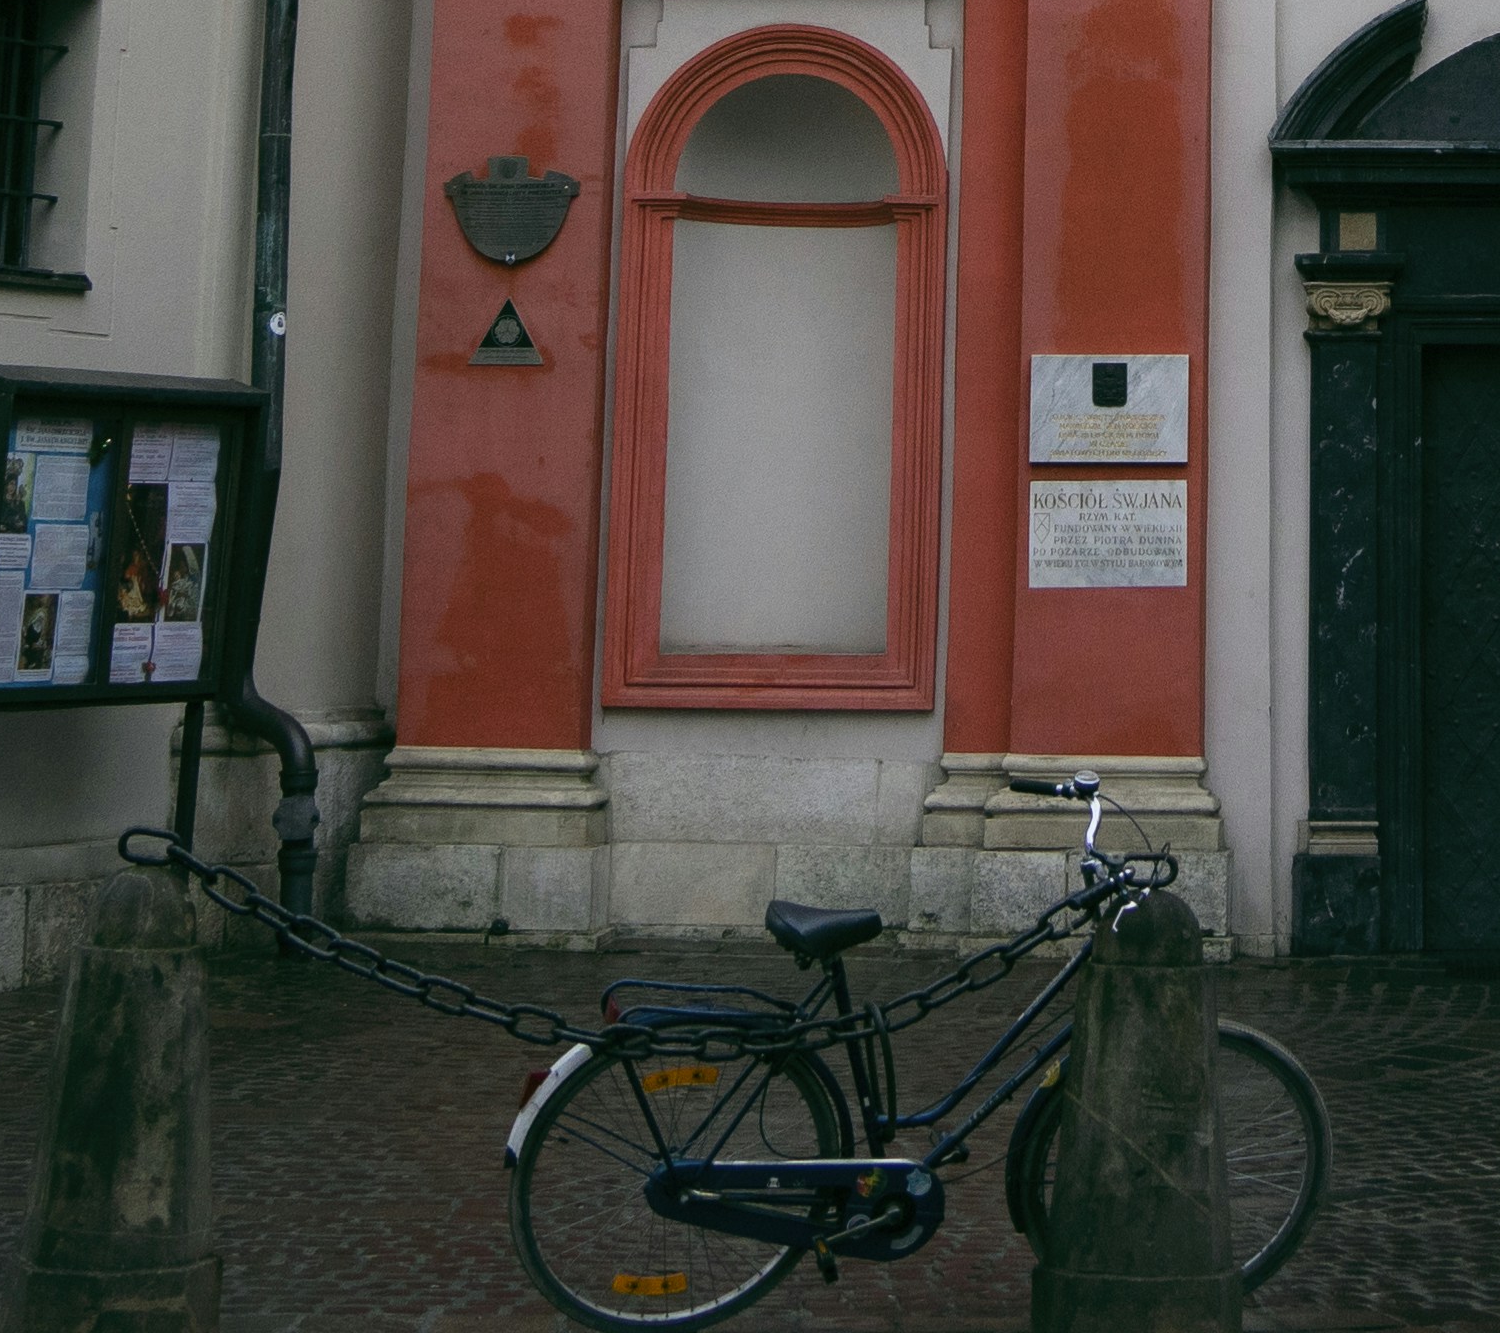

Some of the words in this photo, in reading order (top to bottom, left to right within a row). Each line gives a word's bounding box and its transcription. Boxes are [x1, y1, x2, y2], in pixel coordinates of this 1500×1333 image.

[1033, 487, 1108, 509] KOŚCIÓŁ
[1054, 524, 1117, 533] FUNDOWANY
[1121, 524, 1131, 533] W
[1133, 524, 1166, 533] WIEKU
[1054, 536, 1088, 545] PRZEZ
[1094, 536, 1133, 545] PIOTRA
[1139, 535, 1183, 545] DUNINA
[1033, 547, 1046, 557] PO
[1106, 546, 1183, 557] ODBUDOWANY
[1034, 559, 1043, 568] W
